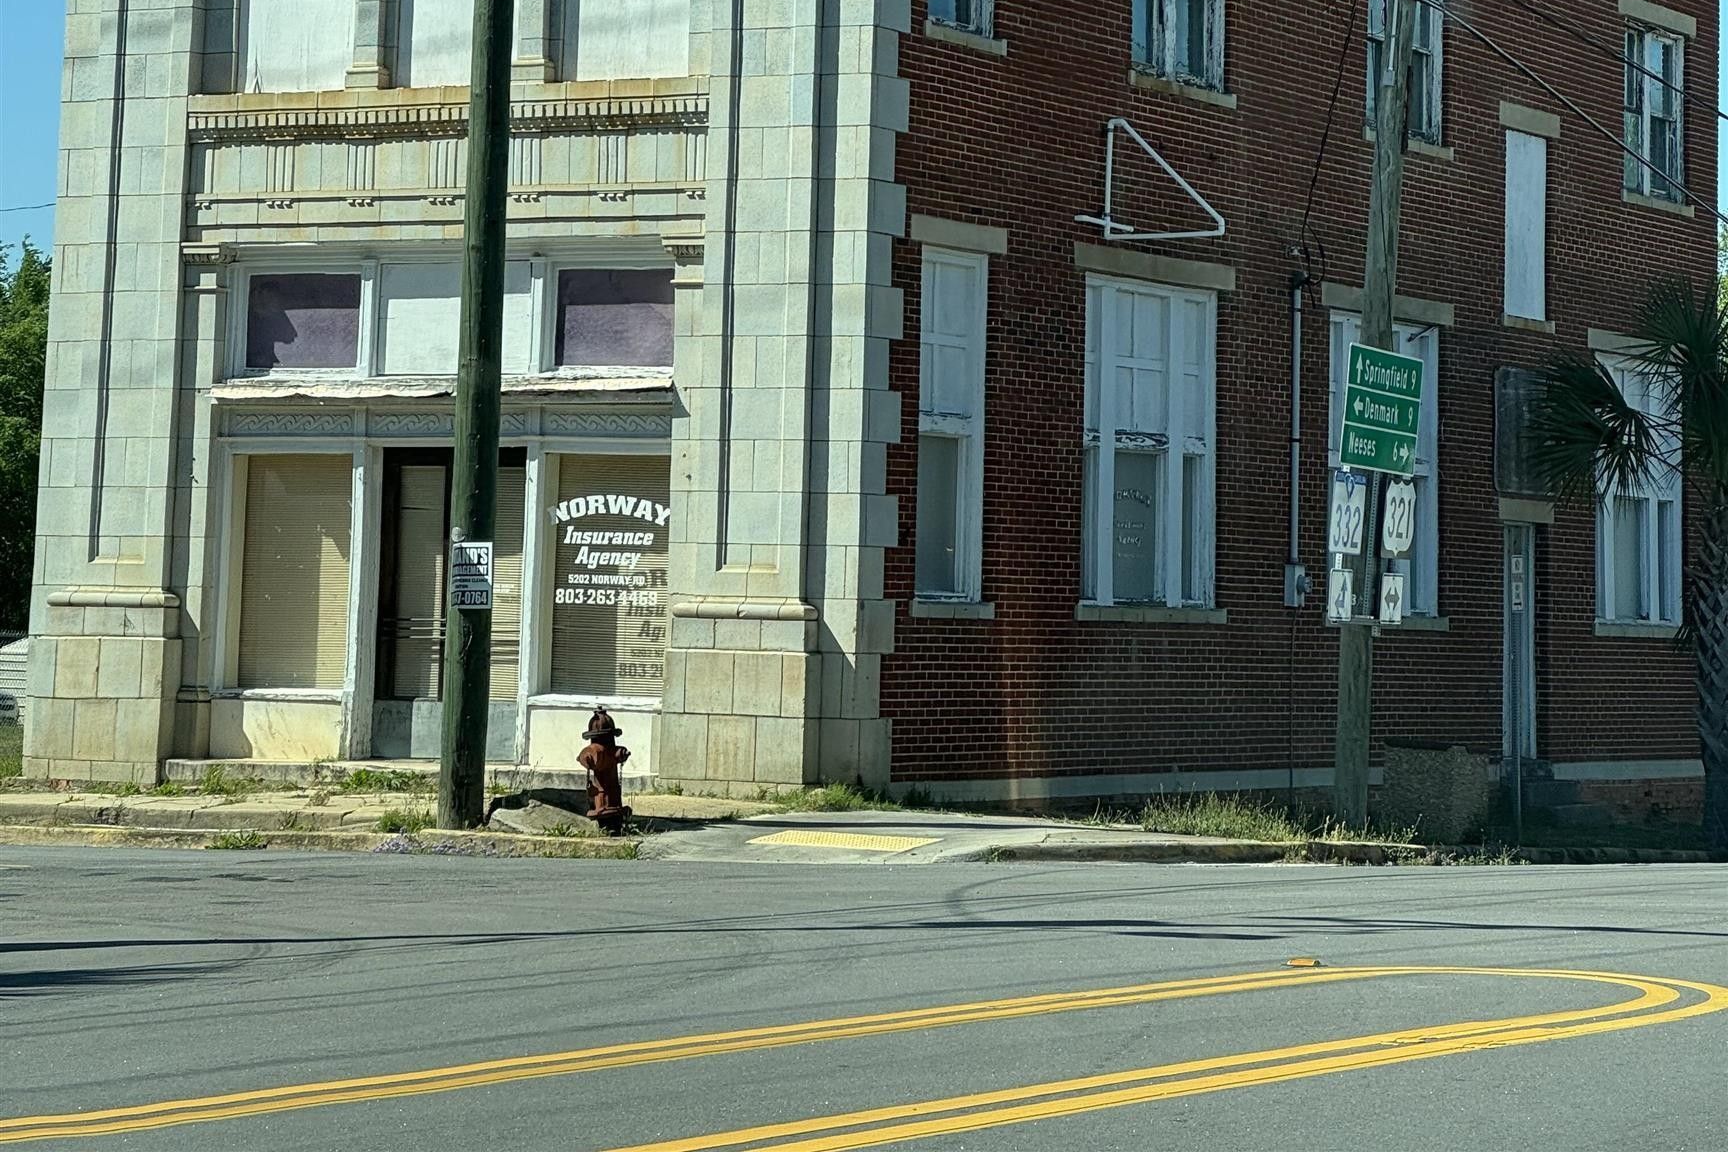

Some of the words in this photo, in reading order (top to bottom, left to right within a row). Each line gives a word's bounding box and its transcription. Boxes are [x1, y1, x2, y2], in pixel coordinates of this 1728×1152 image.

[1364, 359, 1408, 390] Springfield
[1411, 370, 1417, 390] 9
[1364, 396, 1399, 425] Denmark
[1408, 406, 1414, 427] 9
[1348, 431, 1376, 457] Neeses
[1392, 441, 1398, 461] 6
[547, 494, 671, 527] NORWAY
[1387, 496, 1412, 540] 321
[563, 525, 655, 546] Insurance
[1333, 503, 1361, 549] 332
[574, 545, 642, 569] Agency
[568, 574, 590, 584] 5202
[591, 574, 632, 586] NORWAY
[555, 588, 658, 607] 803-263-4469
